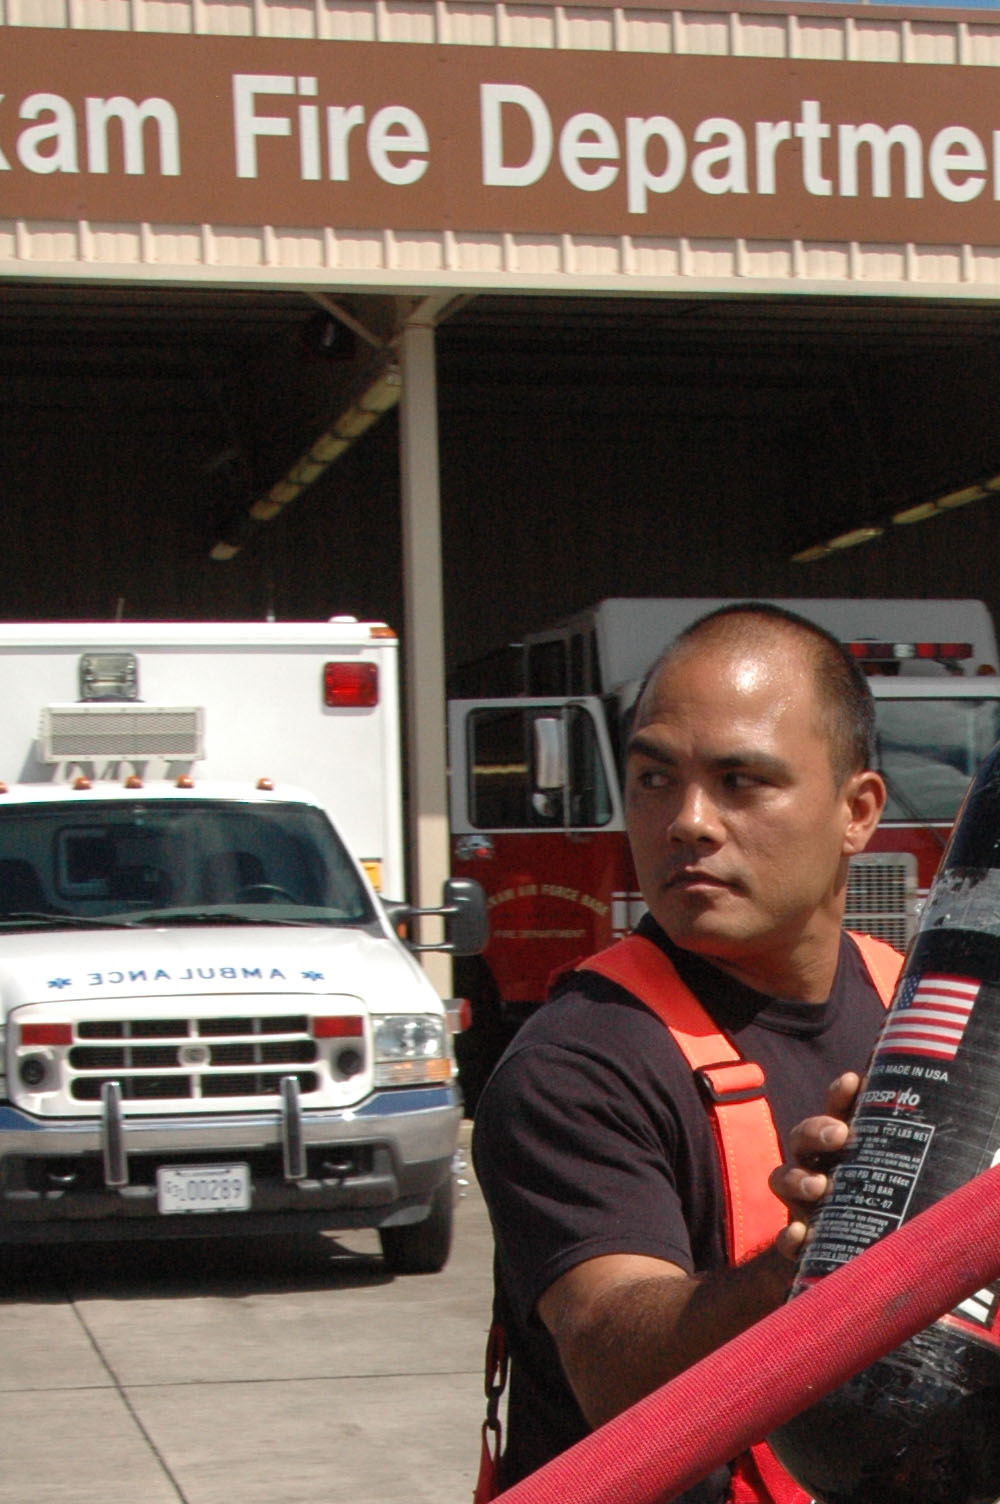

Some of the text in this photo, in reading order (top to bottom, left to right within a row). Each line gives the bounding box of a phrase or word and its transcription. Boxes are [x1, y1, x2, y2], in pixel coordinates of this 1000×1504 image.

[232, 73, 430, 187] Fire
[884, 1064, 911, 1076] MADE
[911, 1066, 925, 1077] IN
[924, 1068, 950, 1082] USA
